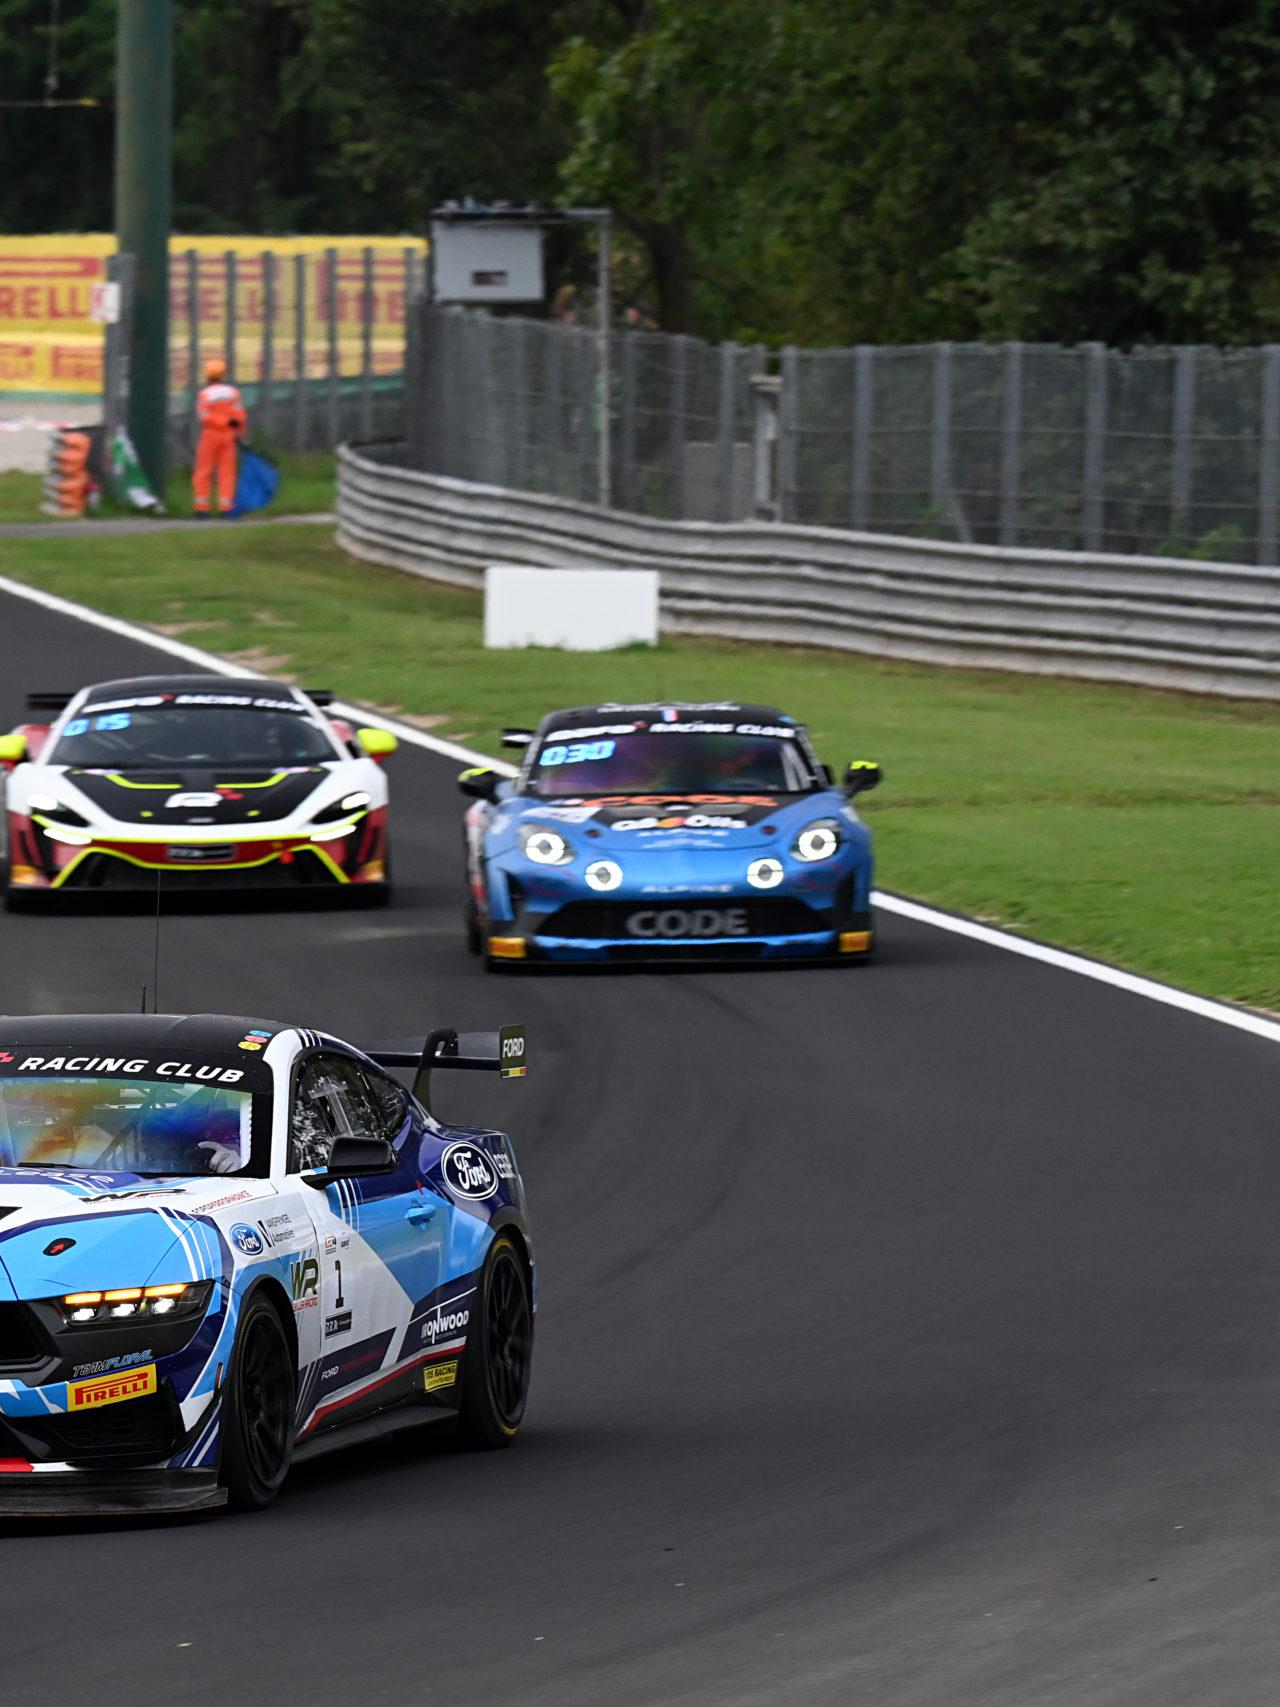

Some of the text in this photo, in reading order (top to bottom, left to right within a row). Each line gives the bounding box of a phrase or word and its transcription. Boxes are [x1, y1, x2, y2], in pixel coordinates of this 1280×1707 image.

[626, 908, 749, 936] CODE
[502, 1037, 525, 1058] FORD
[18, 1057, 149, 1073] RACING
[156, 1062, 245, 1083] CLUB
[290, 1258, 319, 1301] WR
[335, 1260, 345, 1309] 1
[321, 1365, 339, 1381] FORD
[434, 1365, 456, 1377] RACING
[75, 1371, 149, 1405] PIRELLI
